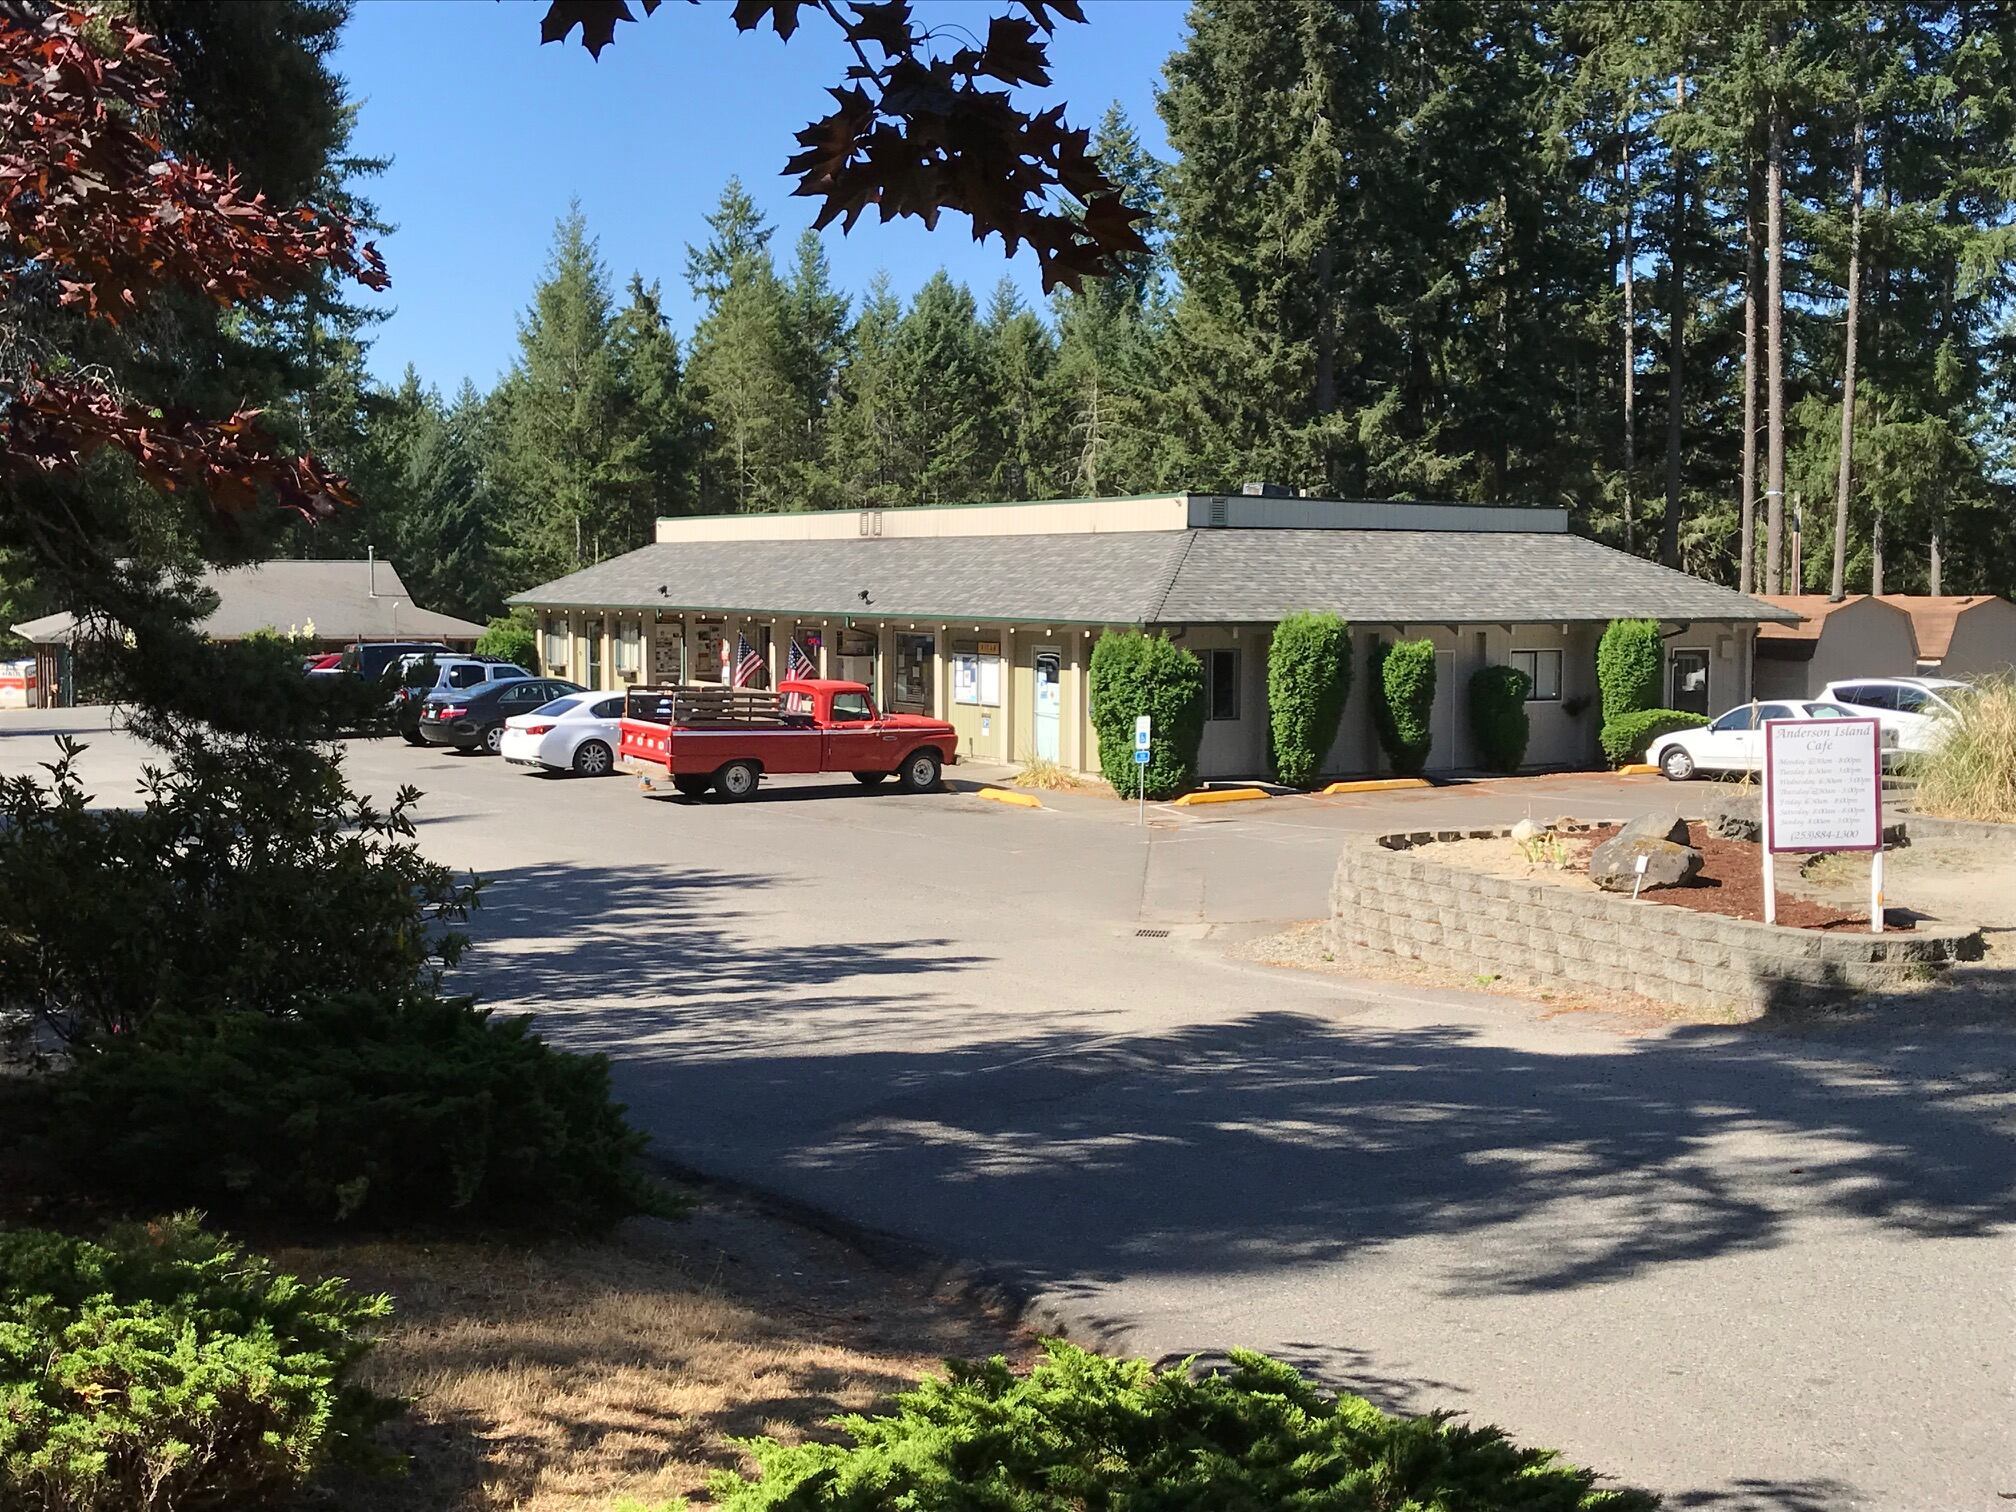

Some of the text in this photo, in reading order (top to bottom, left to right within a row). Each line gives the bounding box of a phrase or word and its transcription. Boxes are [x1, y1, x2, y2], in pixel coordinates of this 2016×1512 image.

[1776, 725, 1871, 739] Anderson Island
[627, 734, 665, 750] FORD
